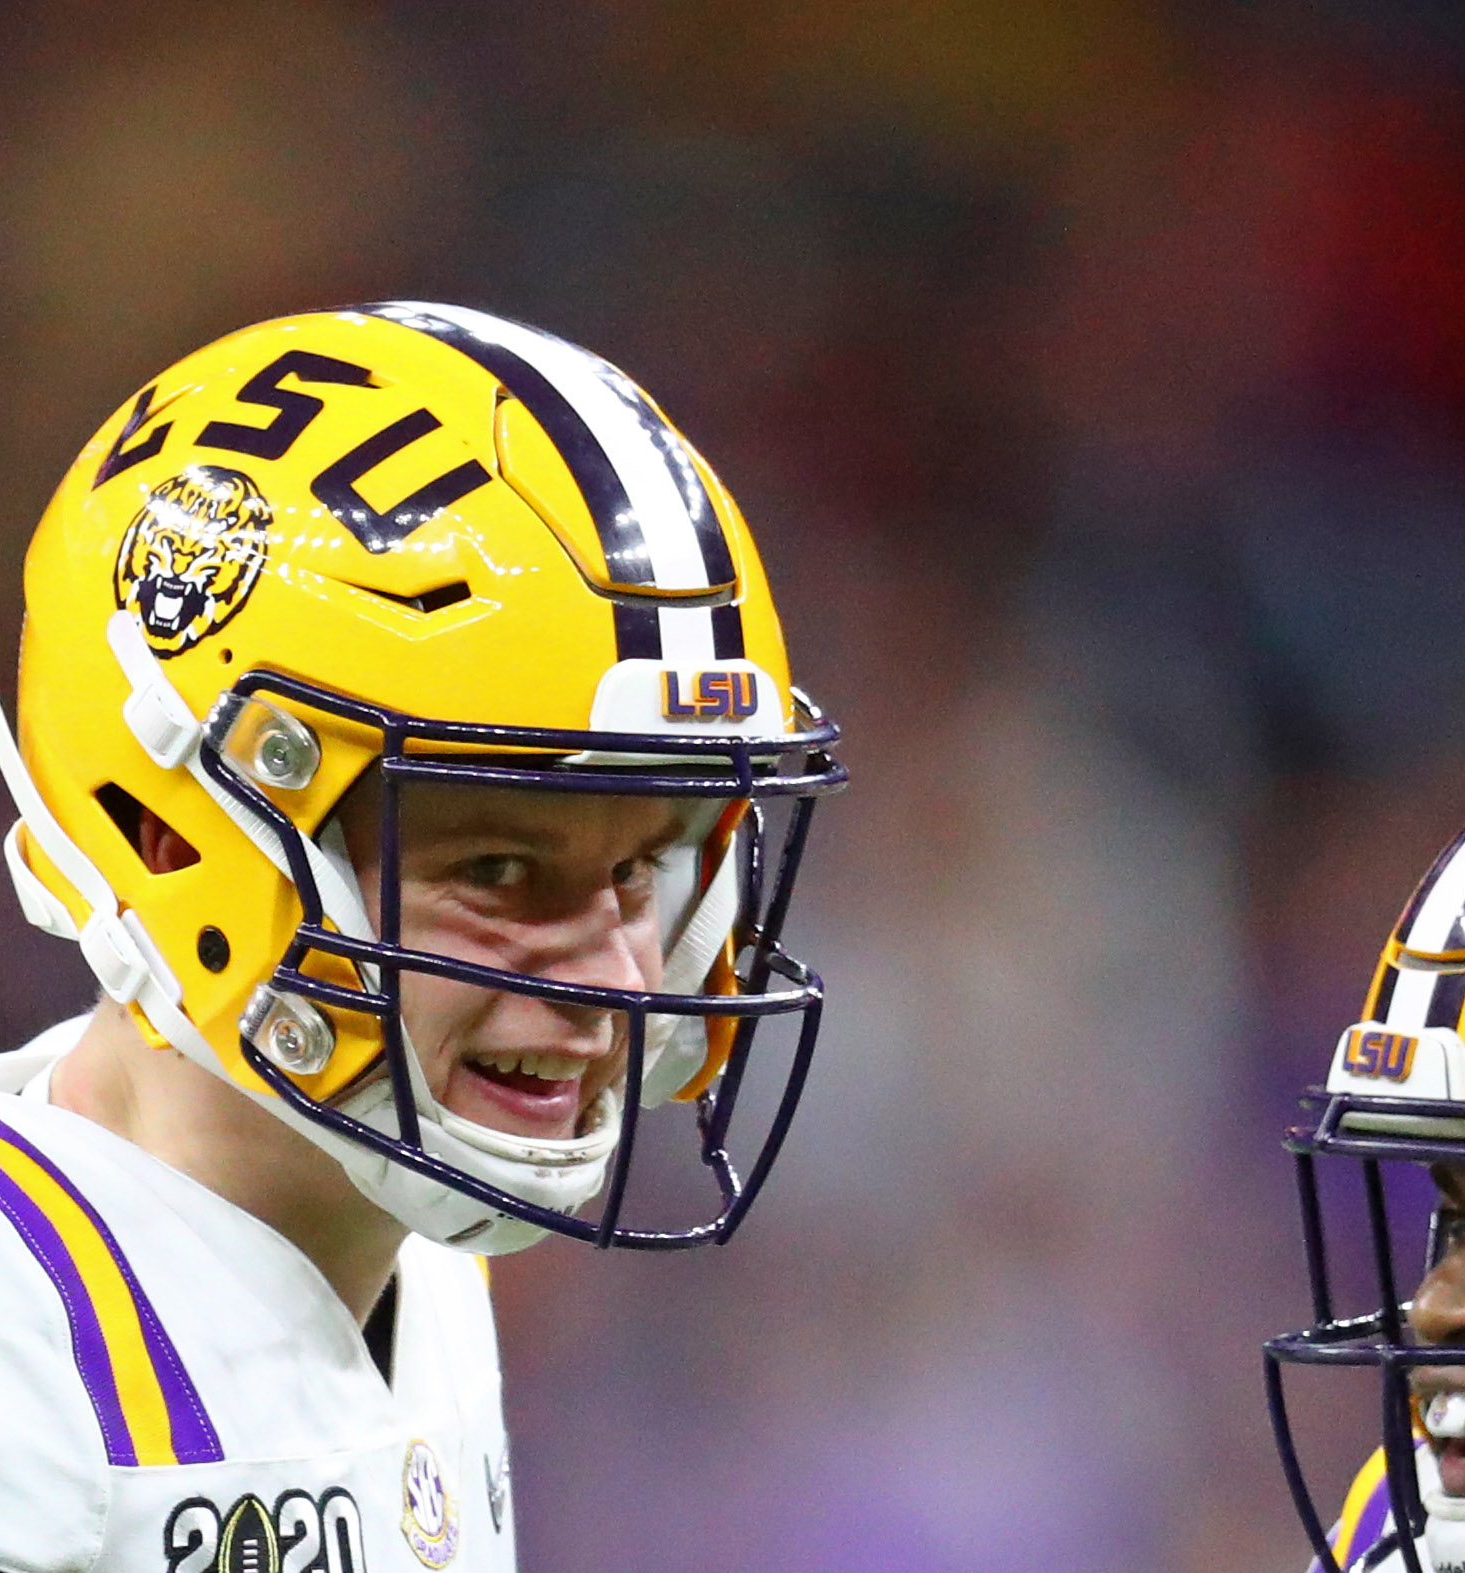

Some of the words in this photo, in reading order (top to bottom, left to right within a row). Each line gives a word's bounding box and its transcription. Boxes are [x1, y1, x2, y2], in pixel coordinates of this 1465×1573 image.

[91, 348, 493, 555] LSU
[660, 669, 758, 722] LSU
[1342, 1029, 1418, 1084] LSU
